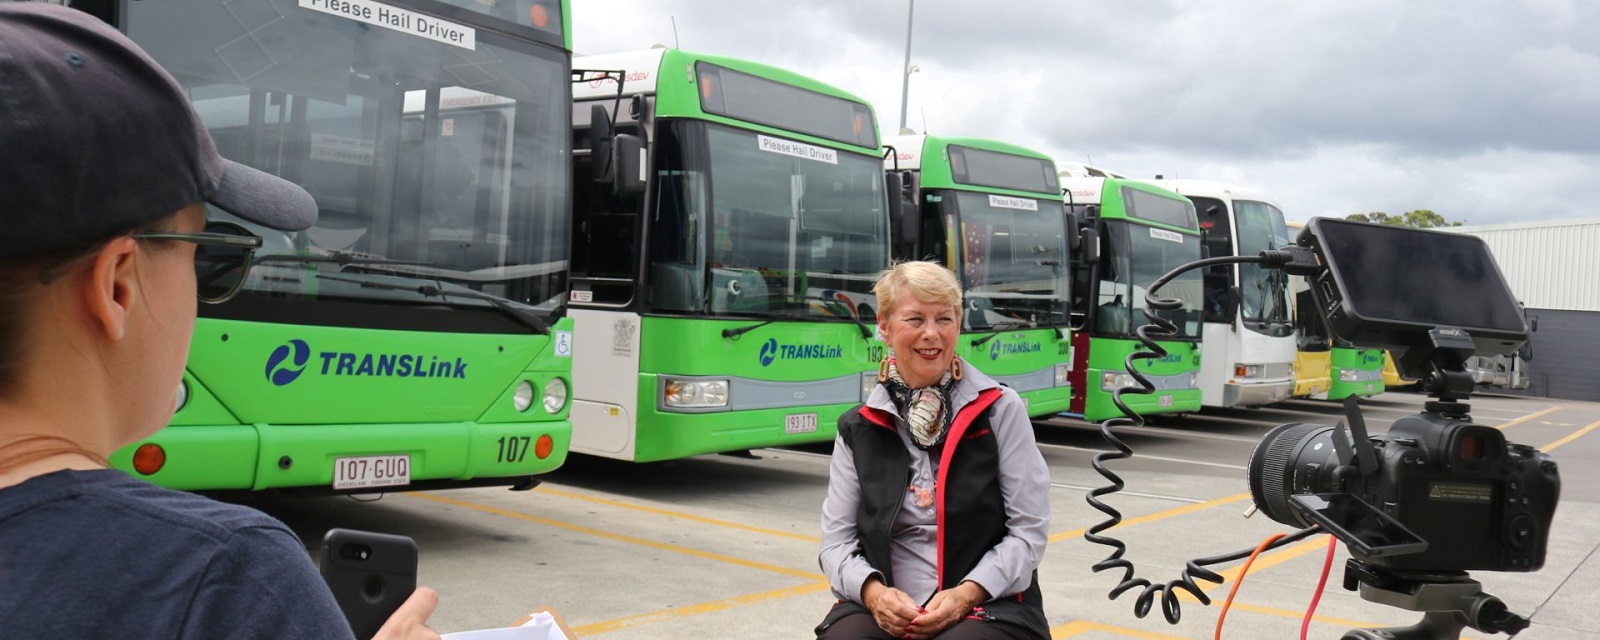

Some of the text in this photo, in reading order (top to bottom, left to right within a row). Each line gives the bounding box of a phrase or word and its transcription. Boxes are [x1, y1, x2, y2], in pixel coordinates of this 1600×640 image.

[378, 7, 410, 29] Hail
[416, 18, 465, 43] Driver
[763, 138, 832, 161] Please Hail Driver
[780, 345, 842, 359] TRANSLink
[867, 345, 882, 363] 193
[319, 352, 467, 379] TRANSLink
[497, 436, 531, 463] 107
